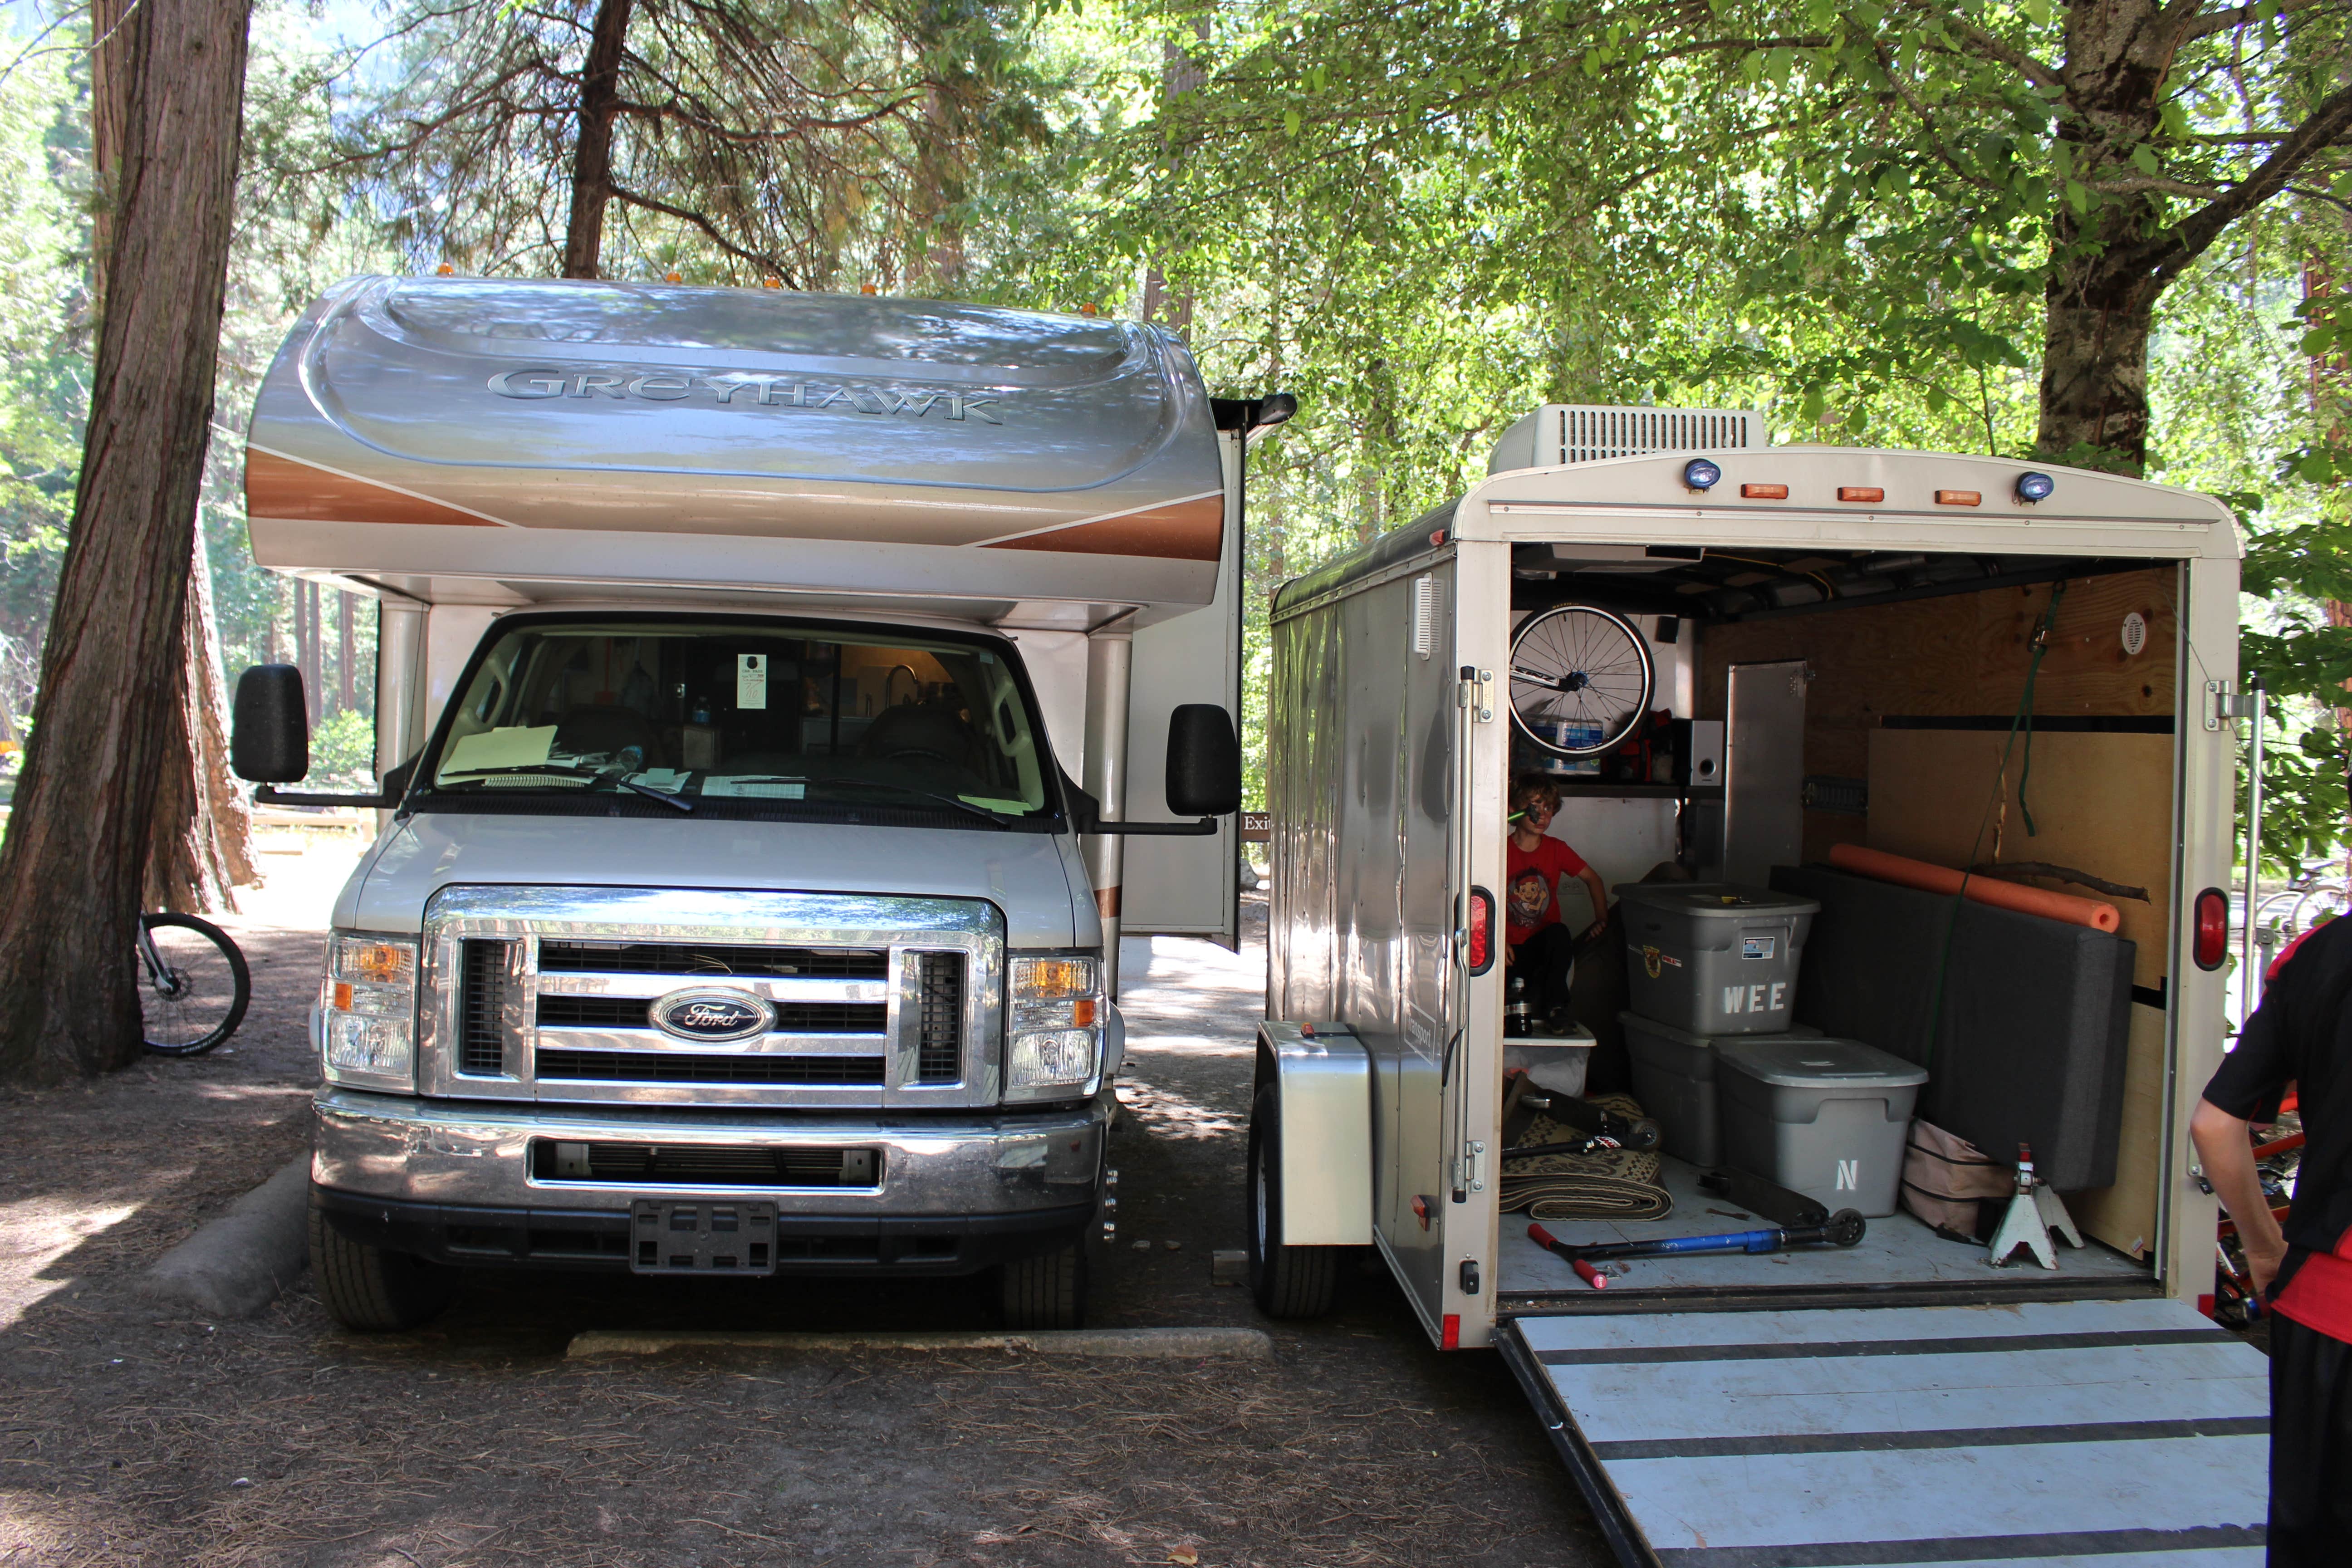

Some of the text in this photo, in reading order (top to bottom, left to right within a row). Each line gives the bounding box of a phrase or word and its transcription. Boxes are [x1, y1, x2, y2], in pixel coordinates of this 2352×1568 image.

[487, 368, 1003, 426] GREYHAWK
[1724, 983, 1786, 1014] WEE
[685, 1003, 737, 1027] Ford
[1836, 1160, 1858, 1191] N
